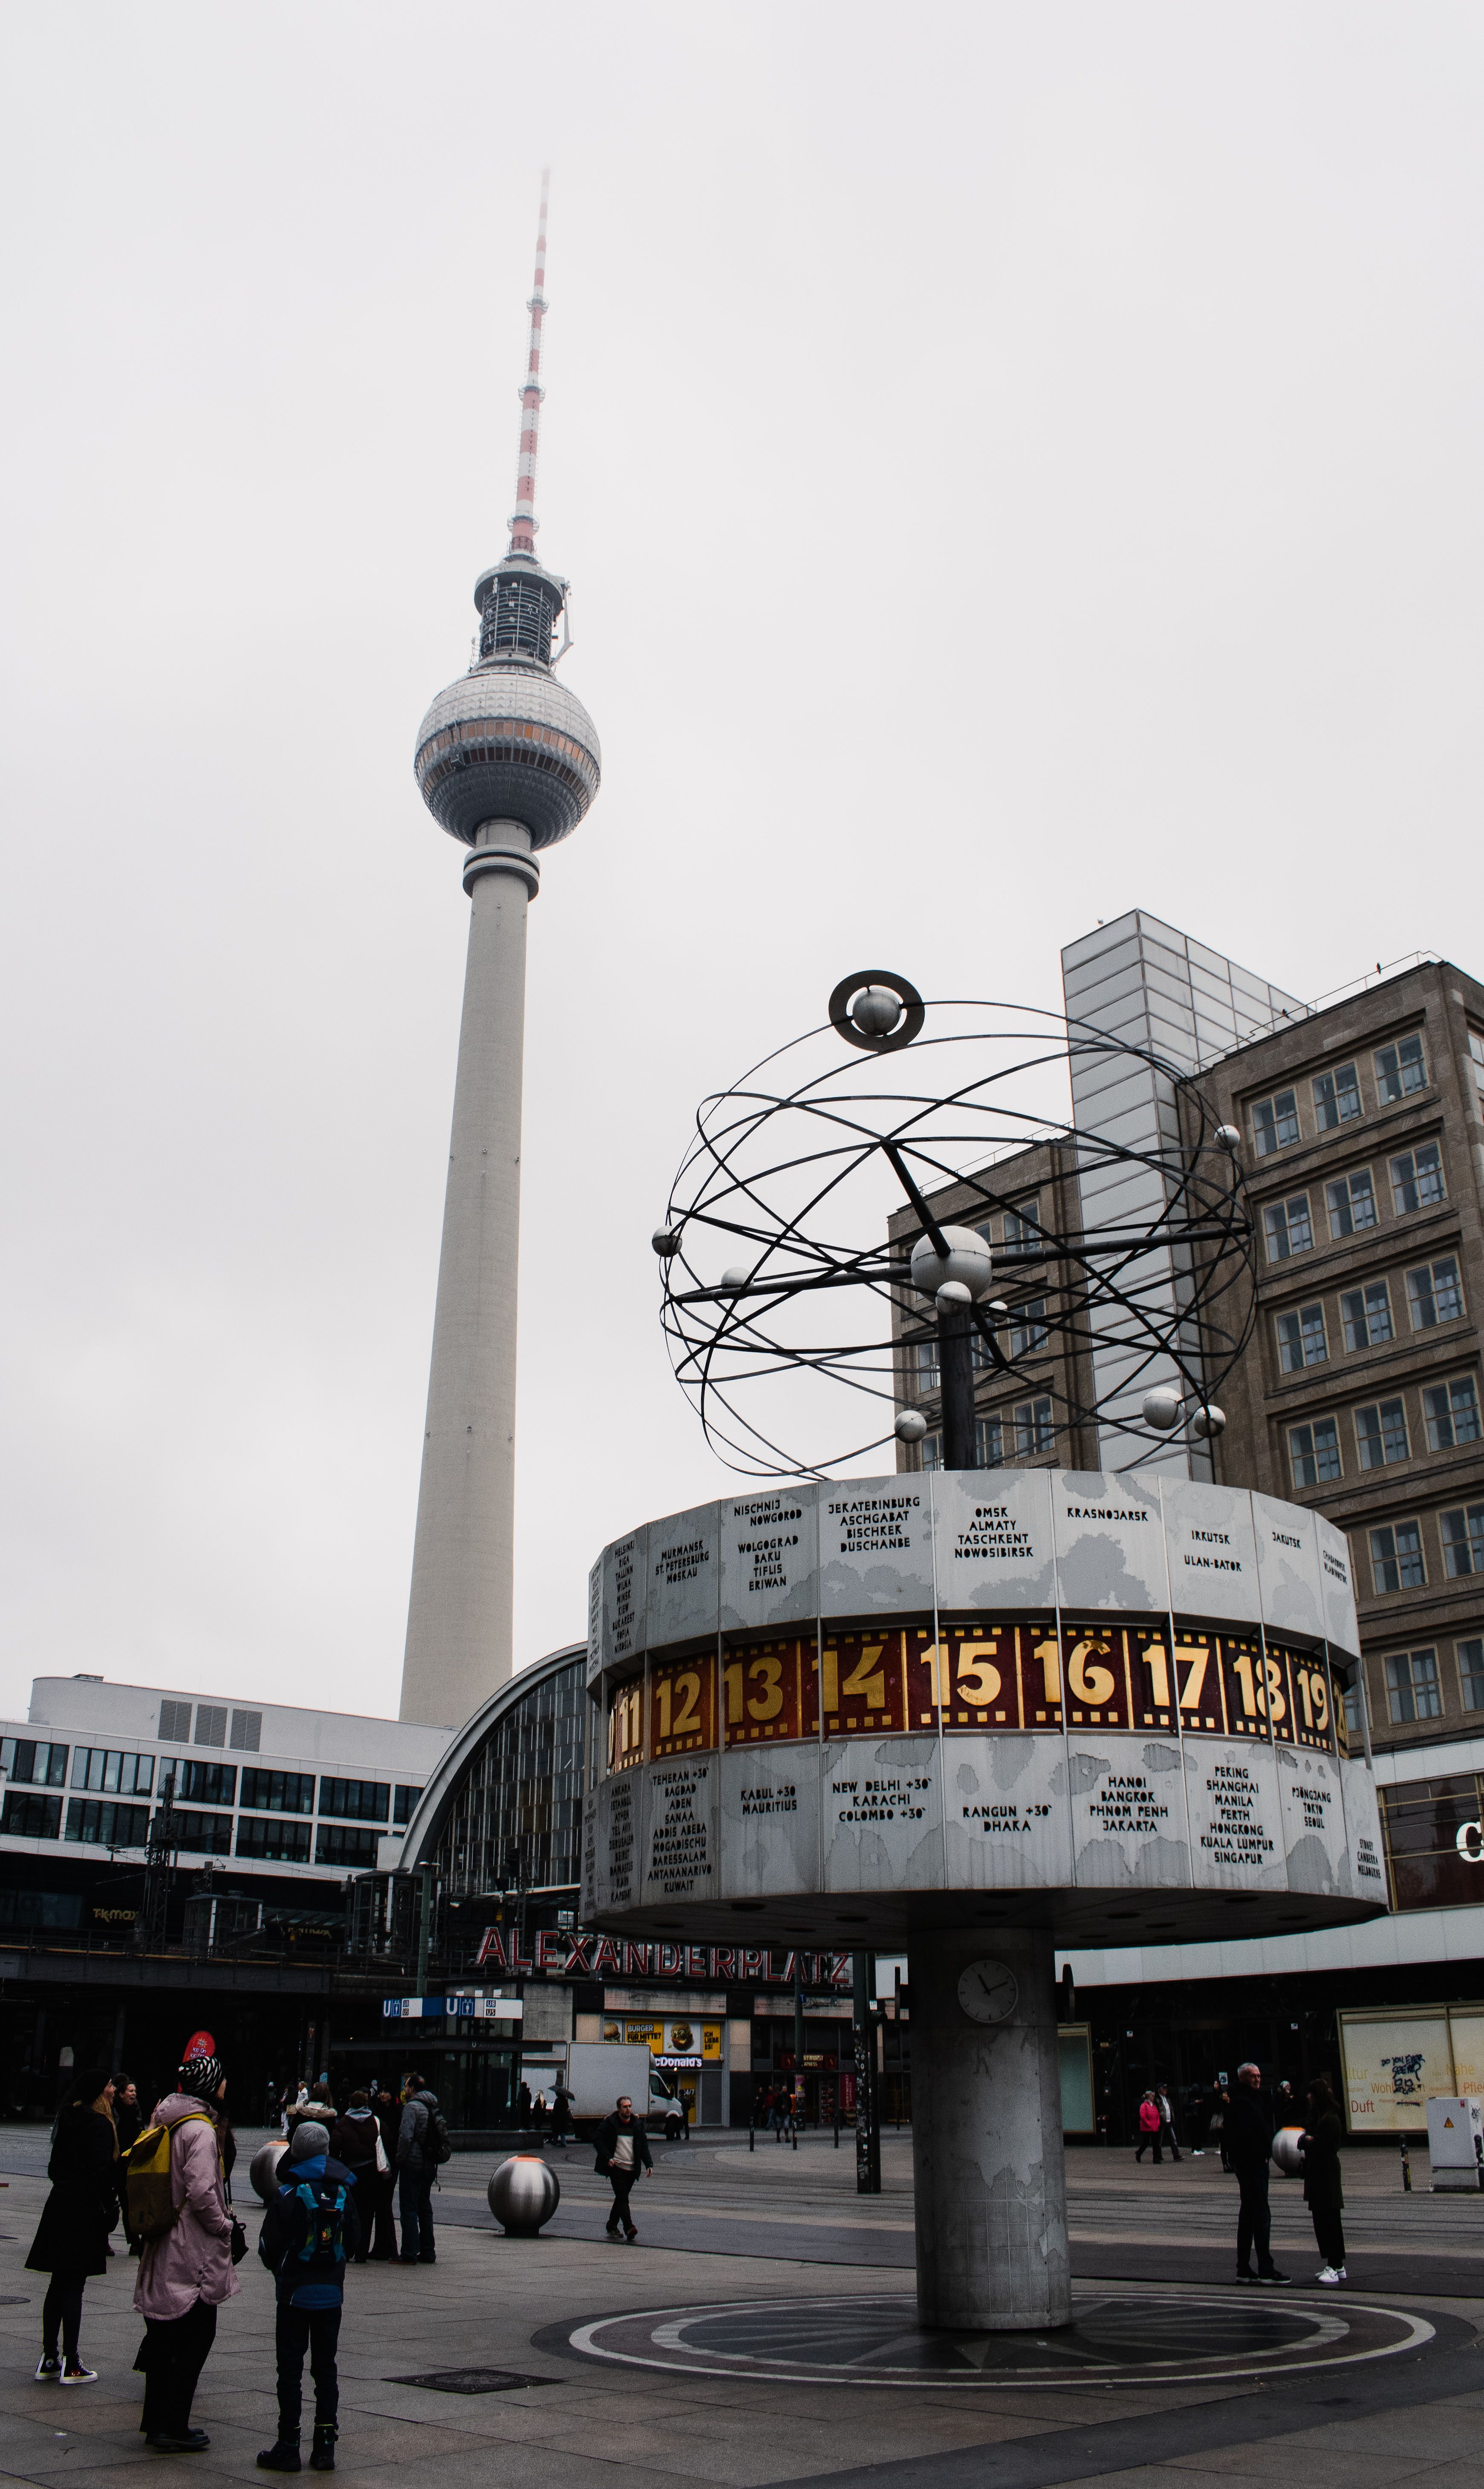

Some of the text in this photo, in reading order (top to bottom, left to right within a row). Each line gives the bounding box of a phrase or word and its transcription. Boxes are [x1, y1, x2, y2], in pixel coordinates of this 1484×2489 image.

[734, 1500, 780, 1516] NISCHNIJ
[828, 1497, 920, 1514] JEKATERINBURG
[975, 1507, 1008, 1517] OMSK
[750, 1509, 802, 1526] NOWGOROD
[840, 1511, 909, 1526] ASCHGABAT
[1067, 1507, 1148, 1521] KRASNOJARSK
[847, 1524, 902, 1538] BISCHKEK
[969, 1520, 1016, 1531] ALMATY
[738, 1535, 798, 1554] WOLGOGRAD
[958, 1534, 1028, 1544] TASCHKENT
[1192, 1530, 1230, 1545] IRKUTSK
[1272, 1532, 1301, 1549] JAKUTSK
[615, 1540, 634, 1558] HELSINKI
[661, 1540, 703, 1561] MURMANSK
[840, 1538, 910, 1552] DUSCHANBE
[755, 1551, 781, 1564] BAKU
[955, 1547, 1034, 1558] NOWOSIBIRSK
[619, 1555, 629, 1568] RIGA
[655, 1551, 709, 1575] ST. PETERSBURG
[1184, 1555, 1242, 1572] ULAN-BATOR
[615, 1565, 633, 1582] TALLINN
[667, 1567, 697, 1584] MOSKAU
[753, 1564, 782, 1577] TIFLIS
[617, 1578, 631, 1592] WILNA
[749, 1577, 786, 1591] ERIWAN
[617, 1589, 631, 1605] MINSK
[618, 1602, 629, 1616] KIEW
[612, 1612, 635, 1631] BUKAREST
[617, 1628, 629, 1641] SOFIA
[614, 1640, 632, 1654] NIKOSIA
[812, 1645, 885, 1712] 14
[921, 1642, 1001, 1706] 15
[1034, 1640, 1115, 1705] 16
[1142, 1644, 1209, 1709] 17
[725, 1657, 783, 1724] 13
[1233, 1656, 1286, 1721] 18
[656, 1671, 701, 1737] 12
[1297, 1669, 1328, 1731] 19
[619, 1690, 640, 1753] 11
[653, 1770, 689, 1786] TEHERAN
[1214, 1766, 1249, 1779] PEKING
[832, 1781, 857, 1794] NEW
[865, 1779, 900, 1792] DELHI
[1108, 1776, 1146, 1788] HANOI
[1206, 1779, 1259, 1794] SHANGHAI
[611, 1784, 631, 1797] ANKARA
[665, 1783, 696, 1798] BAGDAD
[741, 1785, 796, 1801] KABUL +30
[1101, 1791, 1155, 1803] BANGKOK
[1292, 1786, 1331, 1803] PJÖNGJANG
[611, 1795, 631, 1811] ISTANBUL
[669, 1798, 691, 1810] ADEN
[742, 1799, 797, 1815] MAURITIUS
[852, 1794, 910, 1807] KARACHI
[1215, 1794, 1253, 1807] MANILA
[963, 1806, 1017, 1818] RANGUN
[1090, 1805, 1168, 1818] PHNOM PENH
[1221, 1807, 1250, 1821] PERTH
[1303, 1801, 1323, 1815] TOKYO
[615, 1810, 629, 1823] ATHEN
[665, 1811, 694, 1824] SANAA
[839, 1810, 894, 1822] COLOMBO
[1304, 1816, 1325, 1829] SEOUL
[612, 1822, 631, 1836] TEL AVIV
[653, 1823, 707, 1839] ADDIS ABEBA
[984, 1820, 1031, 1832] DHAKA
[1103, 1819, 1158, 1832] JAKARTA
[1210, 1822, 1263, 1836] HONGKONG
[609, 1834, 633, 1851] JERUSALEM
[653, 1836, 706, 1853] MOGADISCHU
[1201, 1836, 1274, 1851] KUALA LUMPUR
[1359, 1838, 1374, 1851] SYDNEY
[615, 1849, 629, 1862] BEIRUT
[653, 1850, 706, 1867] DARESSALAM
[1214, 1852, 1263, 1865] SINGAPUR
[1357, 1851, 1379, 1865] CANBERRA
[610, 1862, 632, 1876] DAMASKUS
[648, 1863, 711, 1881] ANTANANARIVO
[1358, 1865, 1381, 1879] MELBOURNE
[664, 1880, 693, 1893] KUWAIT
[474, 1927, 853, 1984] ALEXANDERPLATZ
[384, 2000, 391, 2017] U
[447, 1998, 458, 2016] U
[627, 2032, 661, 2041] FÜR MITTE?
[655, 2056, 702, 2067] cDonald's
[1351, 2099, 1375, 2113] Duft
